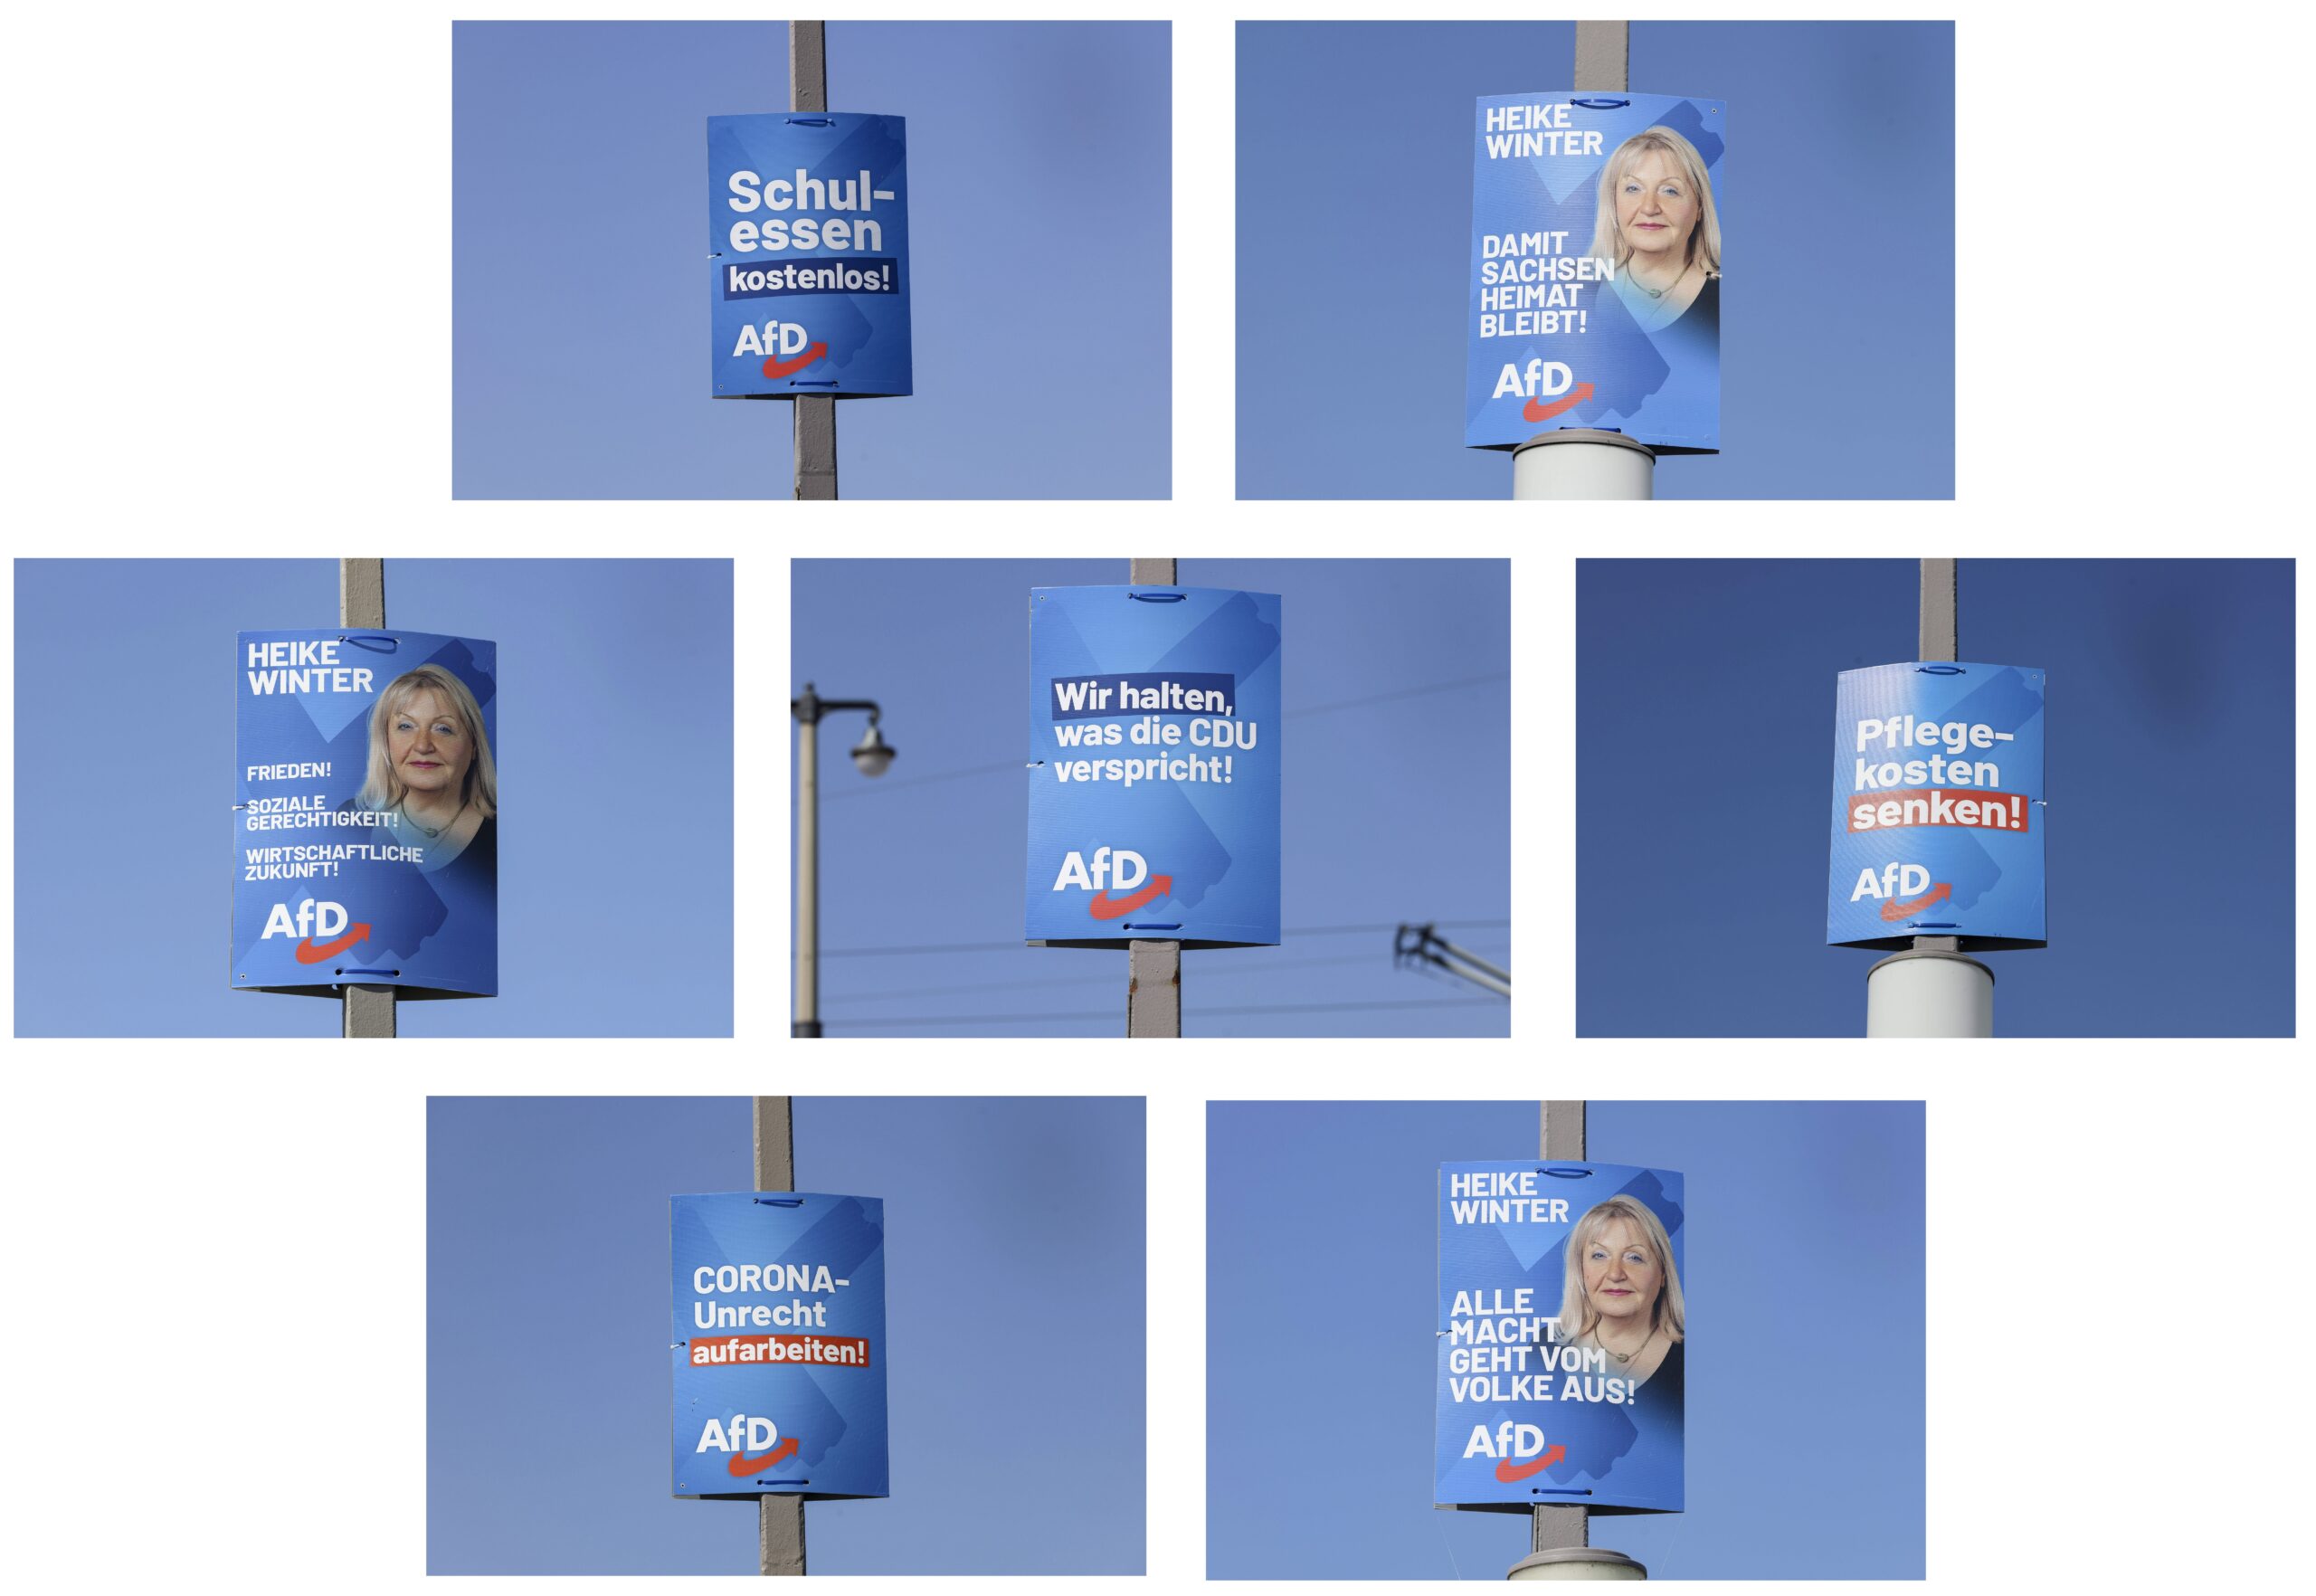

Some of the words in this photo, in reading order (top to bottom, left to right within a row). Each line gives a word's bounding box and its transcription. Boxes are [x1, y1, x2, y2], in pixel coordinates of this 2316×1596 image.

[1486, 103, 1572, 133] HEIKE
[1485, 130, 1604, 160] WINTER
[728, 168, 895, 213] Schul-
[729, 218, 882, 252] essen
[1483, 231, 1570, 260] DAMIT
[729, 262, 889, 292] kostenlos!
[1481, 256, 1616, 285] SACHSEN
[1481, 283, 1584, 312] HEIMAT
[733, 319, 808, 357] AfD
[1479, 309, 1587, 338] BLEIBT!
[1492, 357, 1573, 399] AfD
[248, 640, 340, 668] HEIKE
[248, 668, 374, 696] WINTER
[1055, 680, 1115, 712] Wir
[1119, 680, 1234, 717] halten,
[1054, 725, 1124, 747] was
[1129, 716, 1182, 746] die
[1189, 717, 1257, 750] CDU
[1856, 714, 2014, 755] Pflege-
[247, 762, 332, 782] FRIEDEN!
[1053, 750, 1233, 788] verspricht!
[1855, 754, 1999, 792] kosten
[247, 794, 326, 815] SOZIALE
[1852, 791, 2020, 831] senken!
[246, 811, 399, 831] GERECHTIGKEIT!
[246, 844, 423, 864] WIRTSCHAFTLICHE
[1052, 846, 1148, 891] AfD
[244, 861, 338, 881] ZUKUNFT!
[1849, 861, 1931, 903] AfD
[261, 898, 348, 939] AfD
[1451, 1172, 1538, 1198] HEIKE
[1450, 1198, 1570, 1225] WINTER
[693, 1264, 850, 1295] CORONA-
[694, 1298, 827, 1330] Unrecht
[1450, 1287, 1534, 1317] ALLE
[1450, 1316, 1561, 1346] MACHT
[692, 1336, 866, 1365] aufarbeiten!
[1448, 1345, 1533, 1374] GEHT
[1539, 1345, 1607, 1375] VOM
[1448, 1374, 1553, 1403] VOLKE
[1560, 1374, 1636, 1407] AUS!
[696, 1413, 778, 1453] AfD
[1462, 1420, 1545, 1458] AfD
